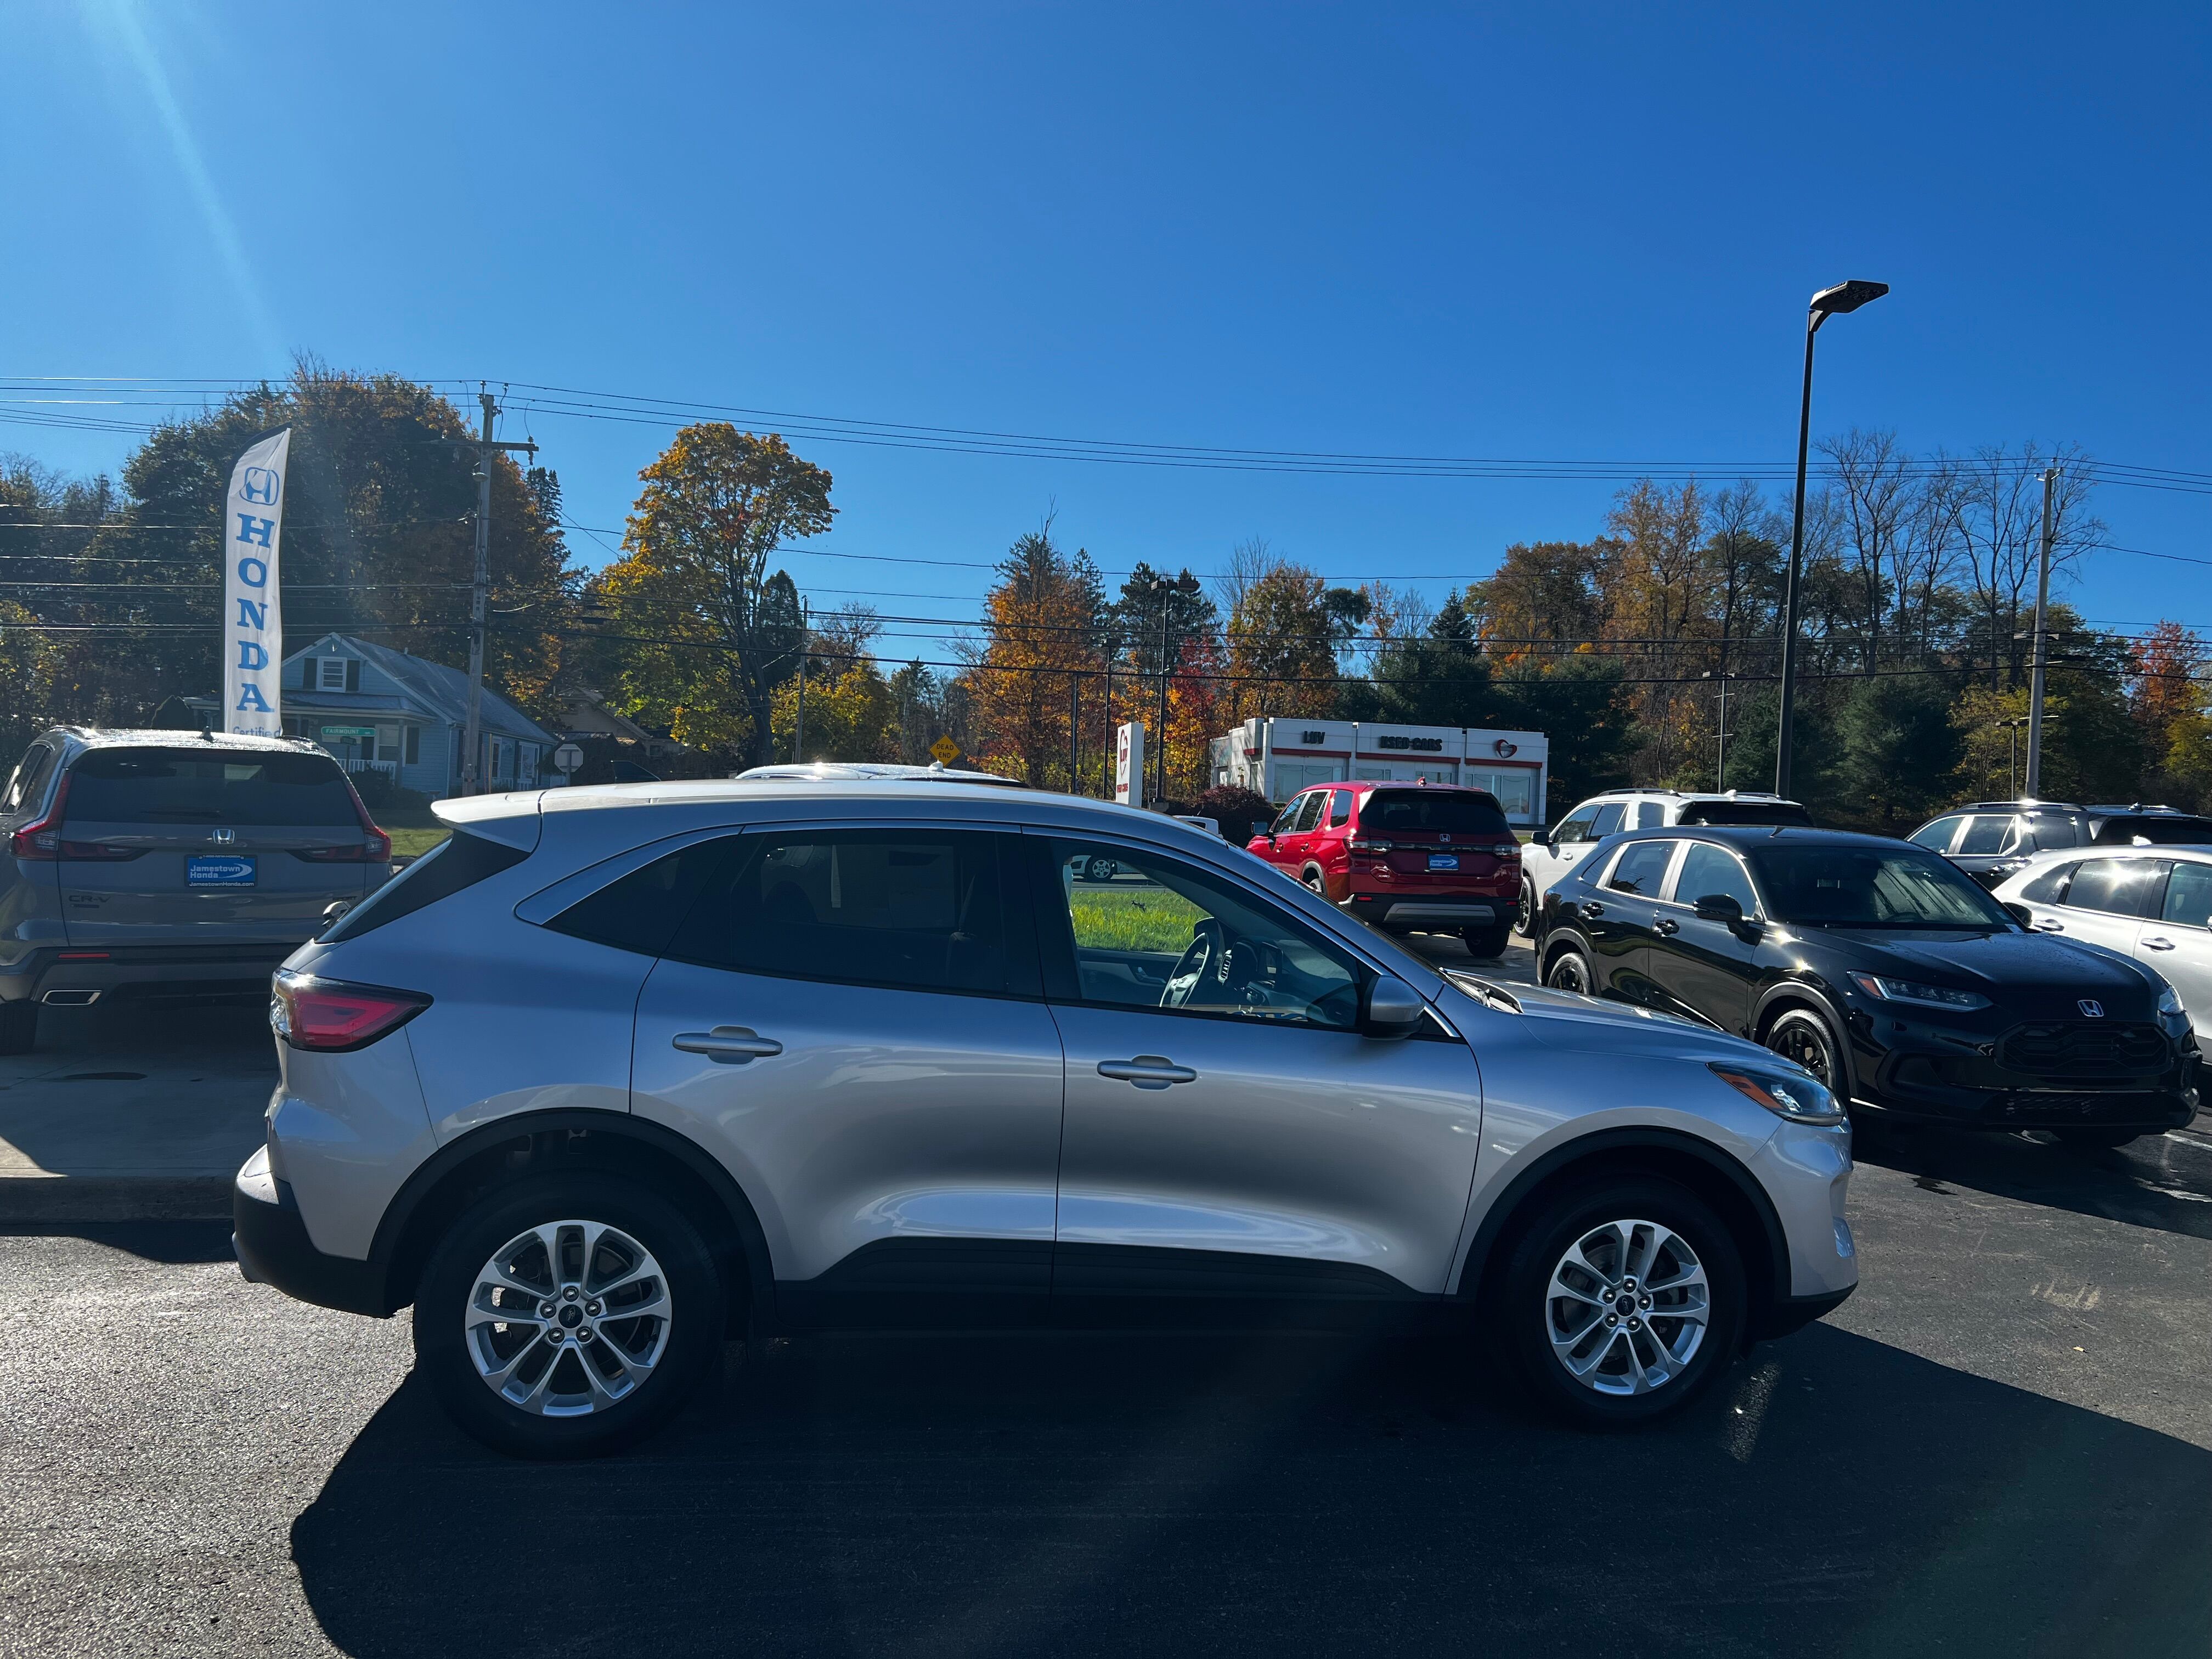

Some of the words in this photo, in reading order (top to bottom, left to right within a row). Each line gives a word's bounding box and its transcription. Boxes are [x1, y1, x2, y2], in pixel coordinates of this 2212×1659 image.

[236, 512, 274, 713] HONDA
[233, 726, 281, 738] Certified
[1302, 731, 1325, 744] LUV
[69, 895, 111, 903] CR-V
